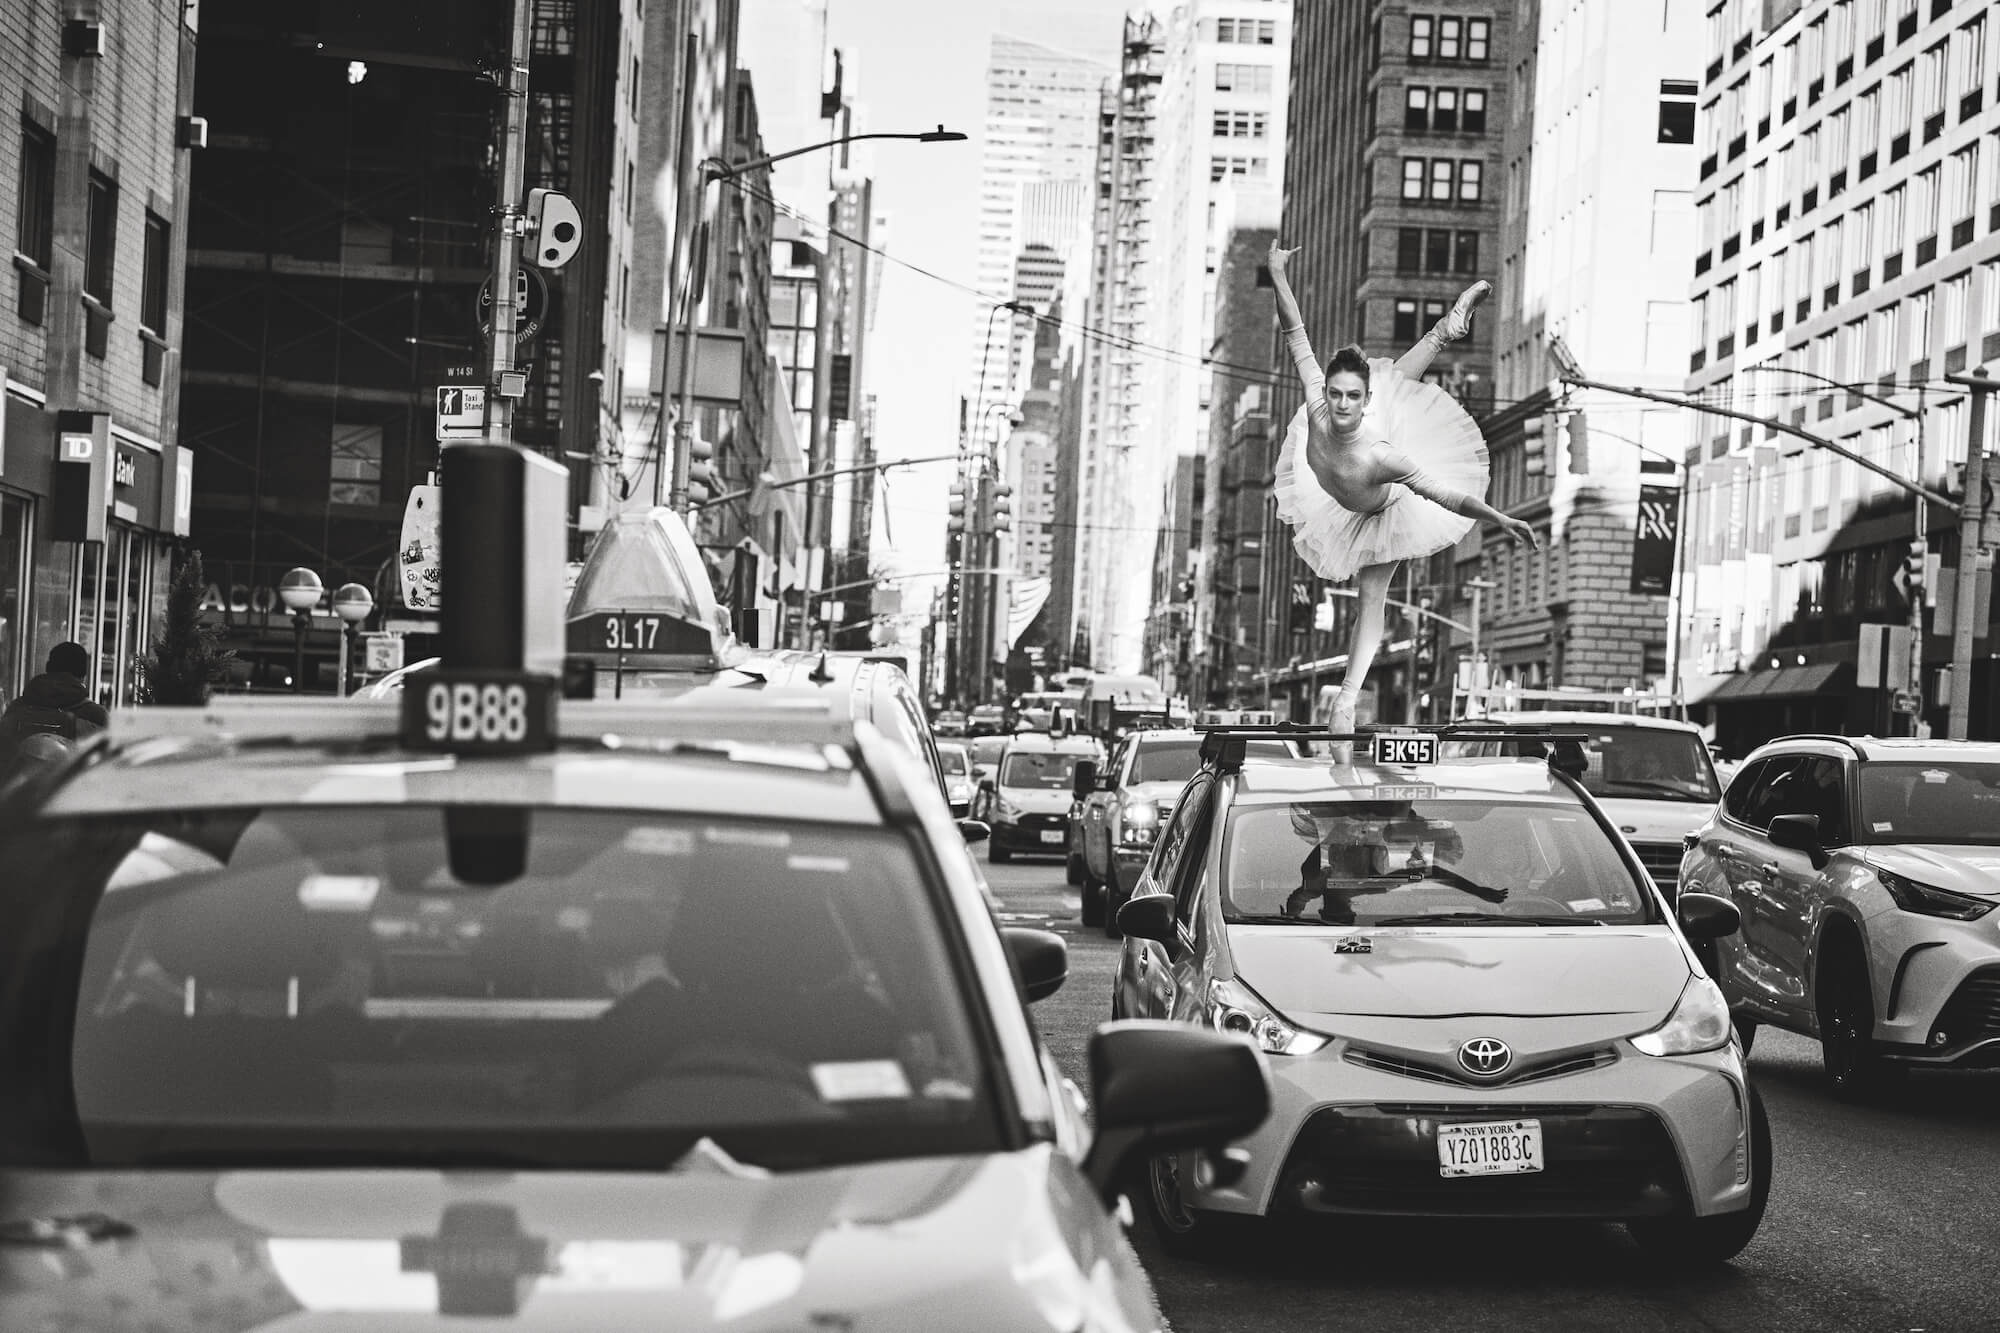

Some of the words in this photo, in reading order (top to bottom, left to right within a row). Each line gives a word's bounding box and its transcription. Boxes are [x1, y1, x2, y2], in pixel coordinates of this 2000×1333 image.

[447, 367, 455, 377] W
[456, 367, 465, 377] 14
[464, 393, 478, 401] Taxi
[464, 402, 483, 410] Stand
[63, 437, 93, 458] TD
[116, 451, 135, 488] Bank
[606, 617, 660, 649] 3L17
[426, 682, 526, 740] 9B88
[1384, 740, 1430, 762] 3K95
[1464, 1127, 1487, 1136] NEW
[1488, 1125, 1515, 1135] YORK
[1447, 1134, 1532, 1165] Y201883C
